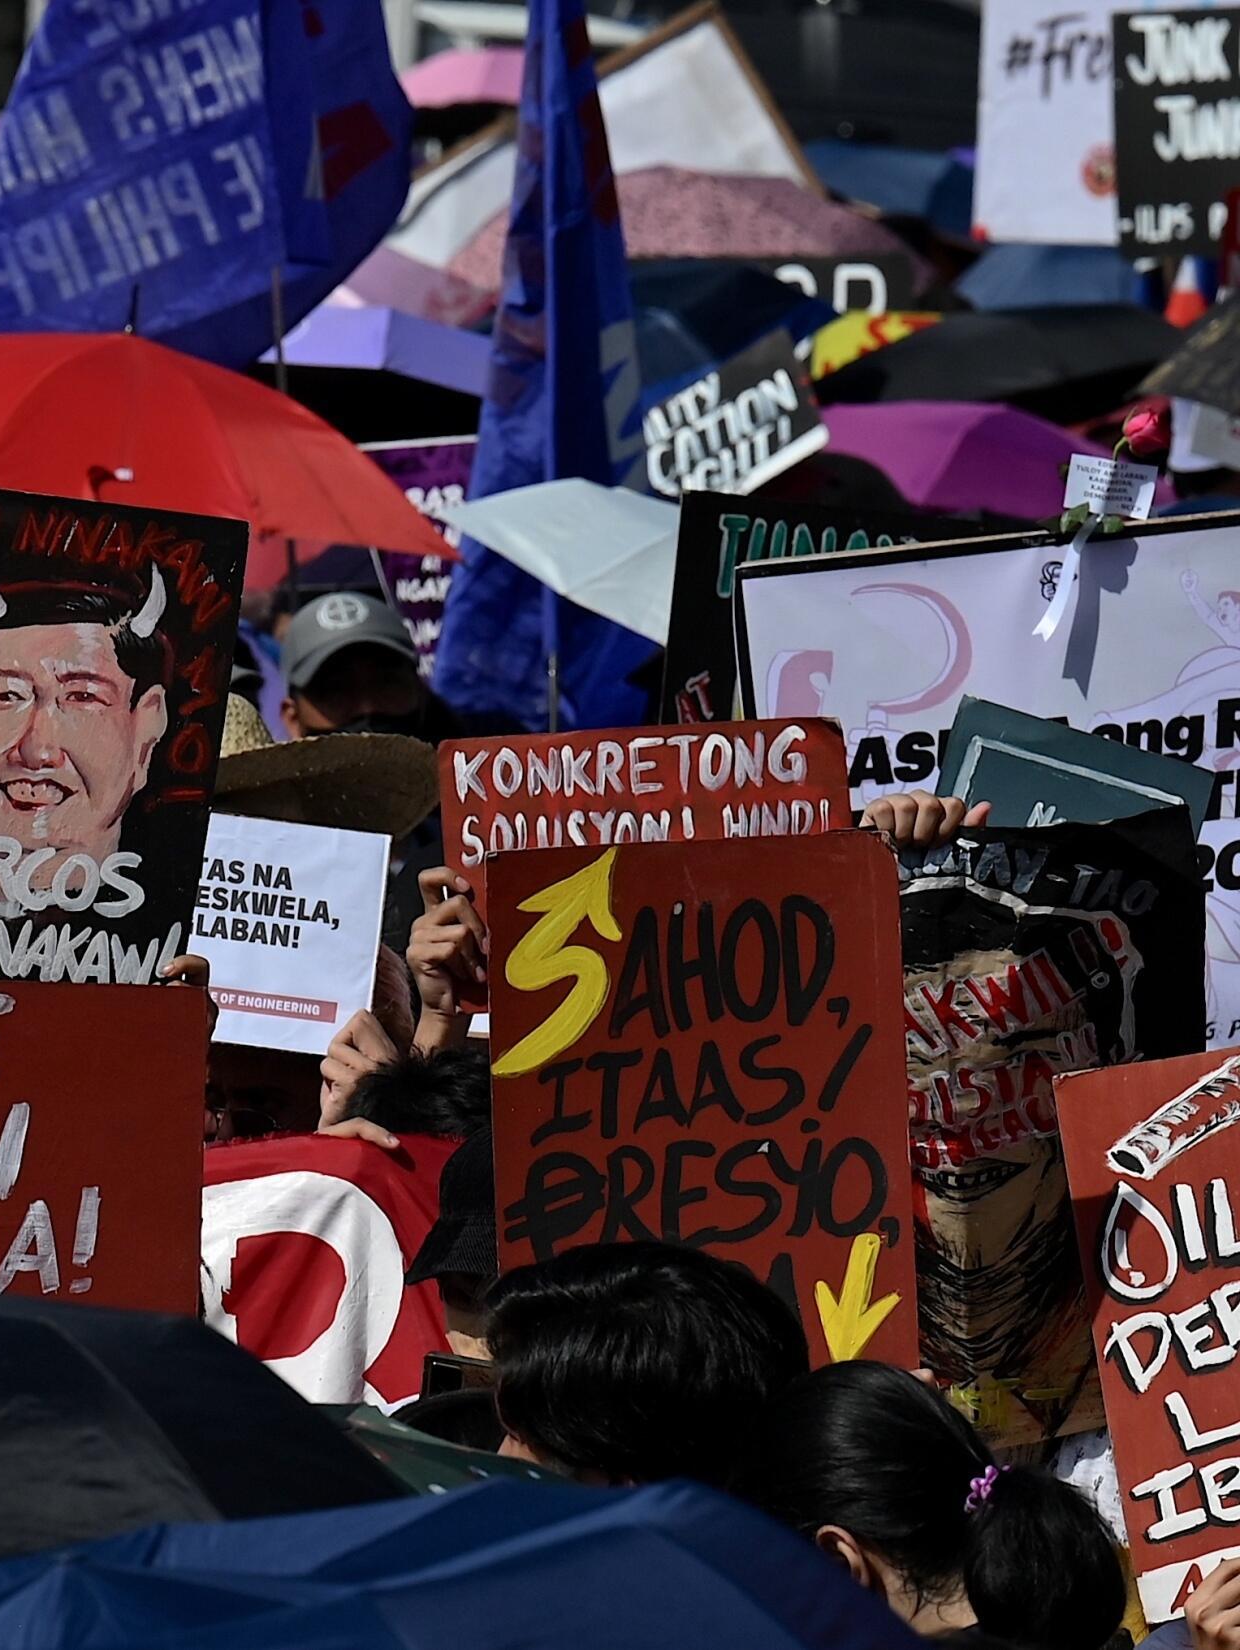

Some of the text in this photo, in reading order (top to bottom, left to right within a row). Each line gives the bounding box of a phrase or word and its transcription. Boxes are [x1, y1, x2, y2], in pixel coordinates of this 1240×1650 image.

[453, 724, 807, 804] KONKRETONG
[252, 863, 293, 891] NA
[220, 991, 235, 1005] OF
[238, 994, 321, 1016] ENGINEERING
[531, 1025, 872, 1147] ITAAS!
